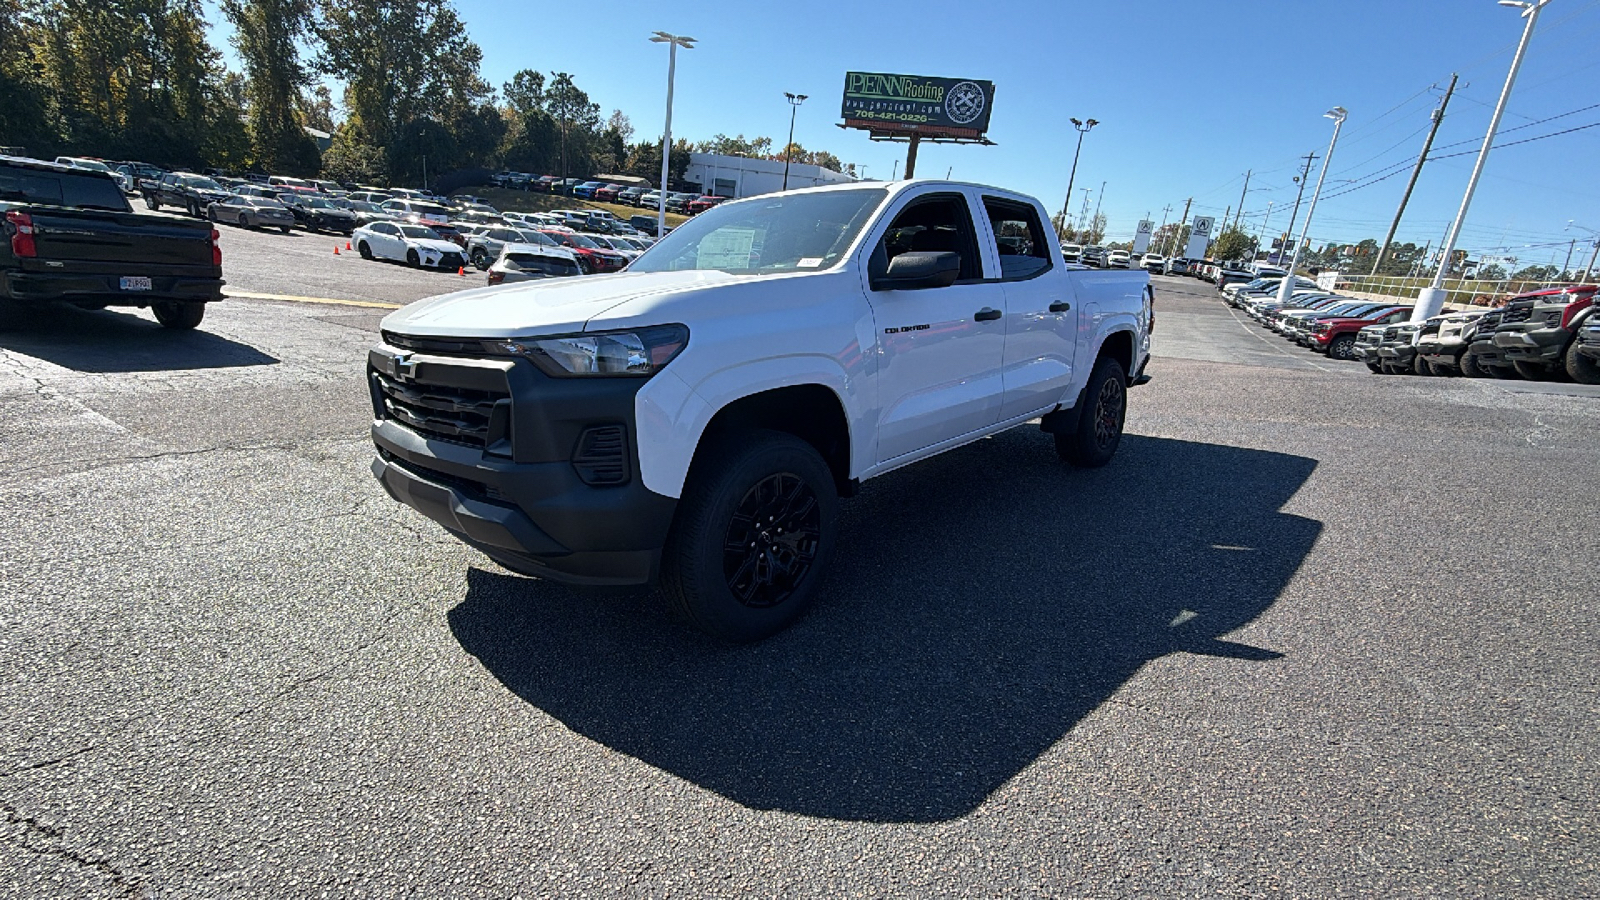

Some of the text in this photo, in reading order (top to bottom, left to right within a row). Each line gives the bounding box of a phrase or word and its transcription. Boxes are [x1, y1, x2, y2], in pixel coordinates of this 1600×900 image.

[847, 73, 907, 96] PENN
[904, 80, 944, 103] Roofing
[885, 324, 930, 334] COLORADO
